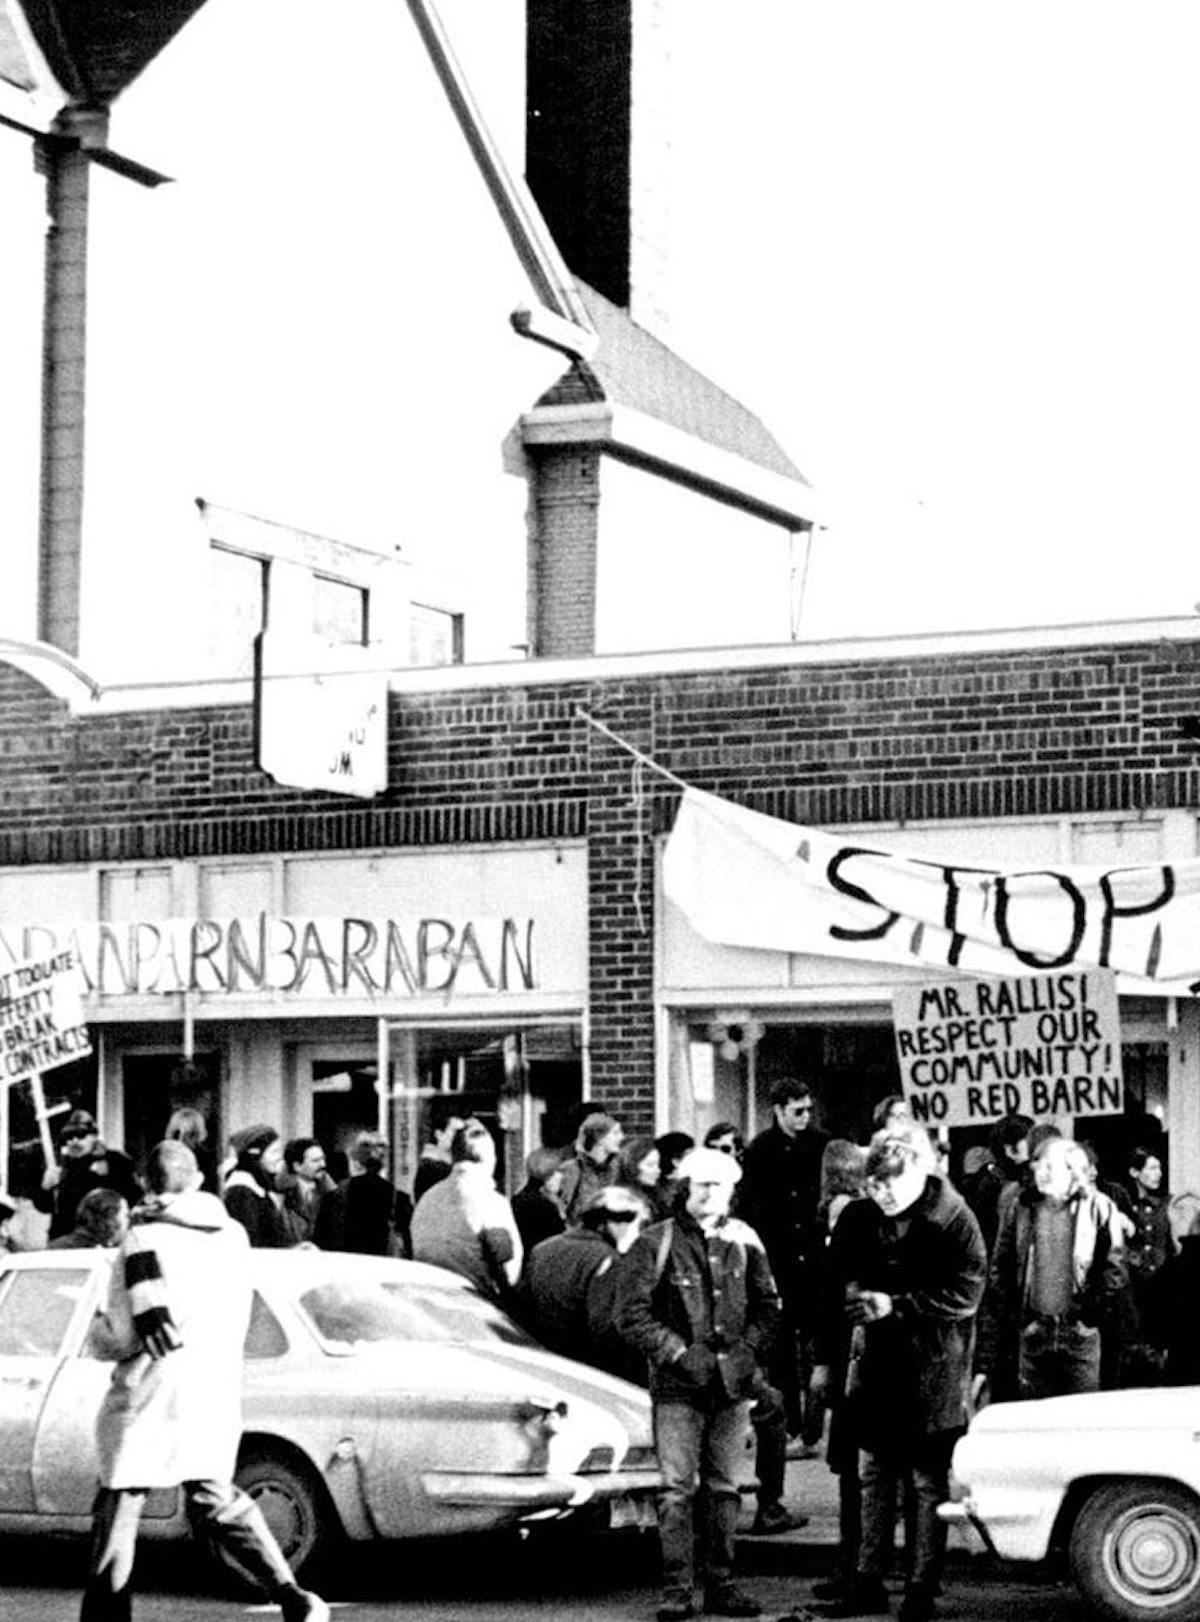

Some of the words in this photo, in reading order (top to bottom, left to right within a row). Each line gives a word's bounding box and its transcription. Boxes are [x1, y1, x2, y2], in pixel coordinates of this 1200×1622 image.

[826, 847, 1174, 968] STOP
[918, 987, 970, 1021] MR.
[976, 974, 1087, 1016] RALLIS!
[4, 1012, 58, 1051] BREAK
[4, 1026, 91, 1076] CONTRACTS
[898, 1015, 1017, 1057] RESPECT
[1037, 1008, 1102, 1043] OUR
[910, 1043, 1112, 1087] COMMUNITY!
[910, 1091, 948, 1122] NO
[967, 1082, 1020, 1118] RED
[1032, 1076, 1120, 1115] BARN
